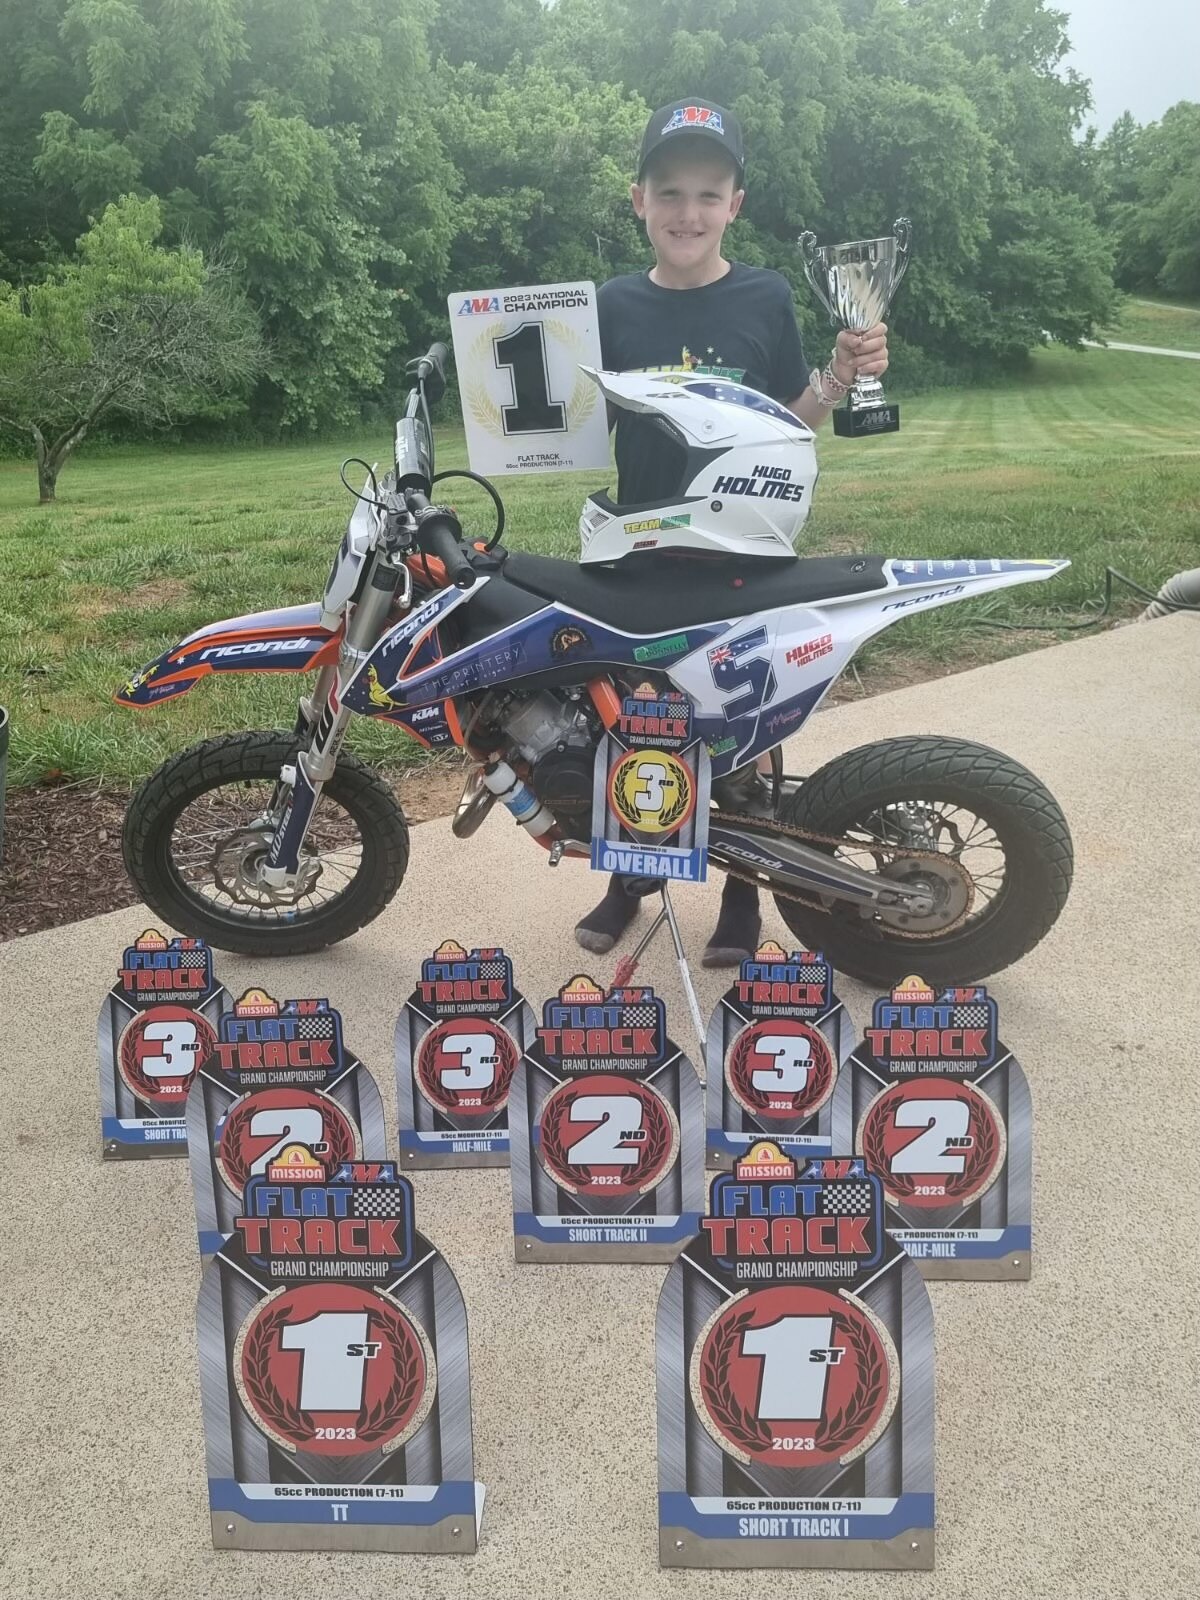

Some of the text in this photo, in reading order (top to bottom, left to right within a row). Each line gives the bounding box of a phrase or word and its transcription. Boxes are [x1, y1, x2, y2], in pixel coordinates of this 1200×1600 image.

[661, 106, 723, 131] AMA
[503, 290, 588, 303] 2023 NATIONAL
[457, 296, 502, 316] AMA
[504, 298, 588, 313] CHAMPION
[492, 321, 568, 436] 1
[536, 453, 560, 461] TRACK
[751, 465, 792, 481] HUGO
[712, 476, 804, 502] HOLMES
[624, 518, 660, 534] TEAM
[381, 600, 440, 657] ricondi
[200, 637, 311, 660] ricondi
[785, 633, 832, 664] HUGO
[797, 641, 833, 668] HOLMES
[423, 647, 520, 692] THE PRINTERY
[412, 707, 440, 721] KTM
[625, 700, 669, 717] FLAT
[617, 714, 688, 737] TRACK
[629, 736, 682, 747] GRAND CHAMPIONSHIP
[715, 841, 784, 870] ricondi
[603, 850, 693, 879] OVERALL
[129, 952, 181, 969] FLAT
[119, 968, 207, 990] TRACK
[428, 963, 480, 980] FLAT
[746, 964, 801, 982] FLAT
[137, 991, 200, 1002] GRAND CHAMPIONSHIP
[418, 979, 507, 1002] TRACK
[735, 981, 825, 1005] TRACK
[436, 1002, 500, 1014] GRAND CHAMPIONSHIP
[751, 1005, 818, 1017] GRAND CHAMPIONSHIP
[552, 1006, 622, 1028] FLAT
[881, 1006, 954, 1029] FLAT
[226, 1018, 298, 1042] FLAT
[538, 1028, 658, 1055] TRACK
[866, 1028, 988, 1056] TRACK
[213, 1039, 336, 1069] TRACK
[562, 1058, 648, 1071] GRAND CHAMPIONSHIP
[889, 1060, 977, 1073] GRAND CHAMPIONSHIP
[240, 1070, 326, 1084] GRAND CHAMPIONSHIP
[159, 1085, 183, 1094] 2023
[458, 1098, 482, 1106] 2023
[769, 1101, 792, 1109] 2023
[144, 1128, 171, 1140] SHORT
[452, 1141, 492, 1153] HALF-MILE
[270, 1167, 323, 1180] mission
[328, 1163, 395, 1183] AMA
[739, 1165, 792, 1177] mission
[800, 1160, 865, 1179] AMA
[591, 1175, 621, 1185] 2023
[914, 1186, 945, 1196] 2023
[256, 1187, 353, 1217] FLAT
[723, 1185, 823, 1216] FLAT
[582, 1217, 633, 1225] PRODUCTION
[235, 1218, 402, 1256] TRACK
[568, 1228, 602, 1242] SHORT
[604, 1228, 638, 1242] TRACK
[702, 1216, 872, 1255] TRACK
[904, 1231, 955, 1239] PRODUCTION
[903, 1242, 956, 1257] HALF-MILE
[270, 1261, 389, 1278] GRAND CHAMPIONSHIP
[736, 1261, 858, 1278] GRAND CHAMPIONSHIP
[314, 1427, 357, 1441] 2023
[772, 1437, 815, 1451] 2023
[274, 1487, 303, 1497] 65cc
[304, 1487, 374, 1498] PRODUCTION
[331, 1503, 349, 1521] TT
[726, 1500, 756, 1511] 65cc
[758, 1501, 830, 1511] PRODUCTION
[739, 1517, 849, 1537] SHORT TRACK I
